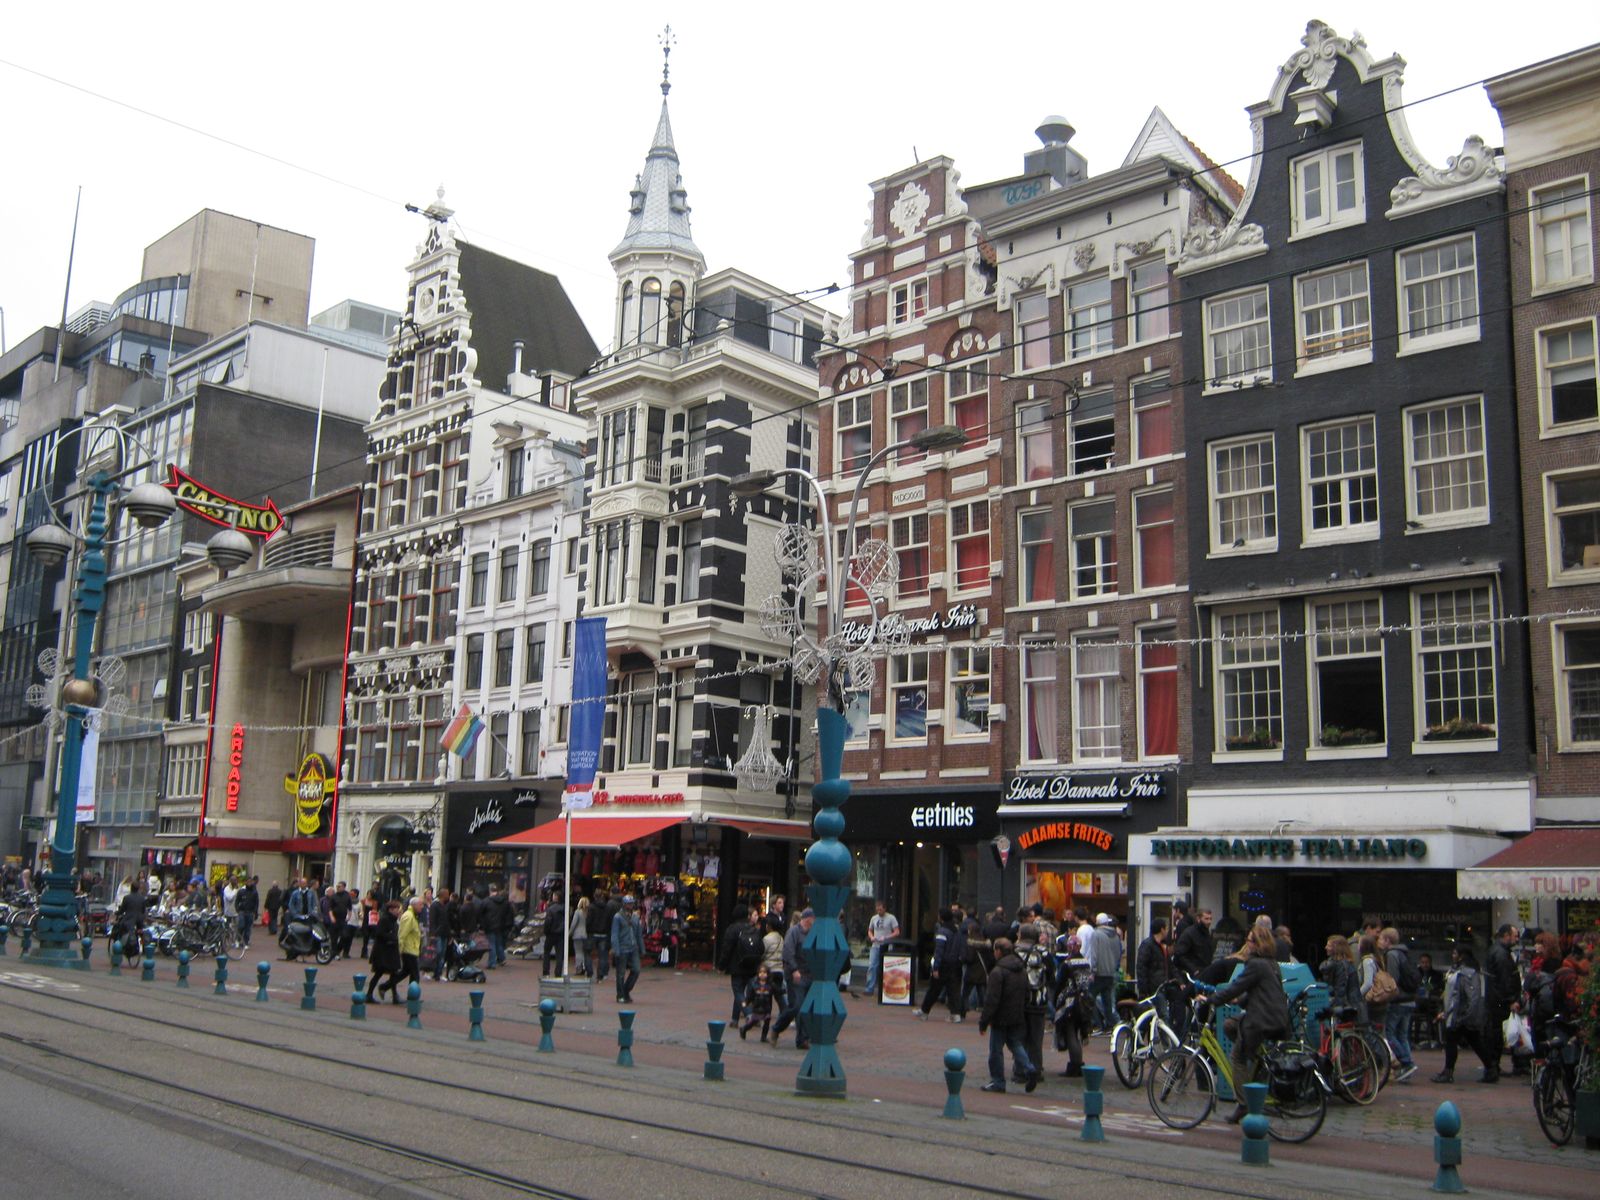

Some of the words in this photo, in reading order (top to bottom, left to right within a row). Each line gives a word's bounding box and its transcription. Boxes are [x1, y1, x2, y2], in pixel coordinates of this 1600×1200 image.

[178, 482, 278, 531] CASINO
[942, 604, 976, 628] Inn
[226, 722, 244, 811] ARCADE
[1006, 776, 1047, 800] Hotel
[1048, 776, 1118, 799] Damrak
[1120, 773, 1160, 797] Inn
[925, 801, 974, 827] etnies
[1018, 822, 1071, 850] VLAAMSE
[1073, 822, 1114, 850] FRITES
[1150, 838, 1295, 858] RISTORANTE
[1300, 837, 1428, 858] ITALIANO
[1530, 877, 1590, 894] TULIP
